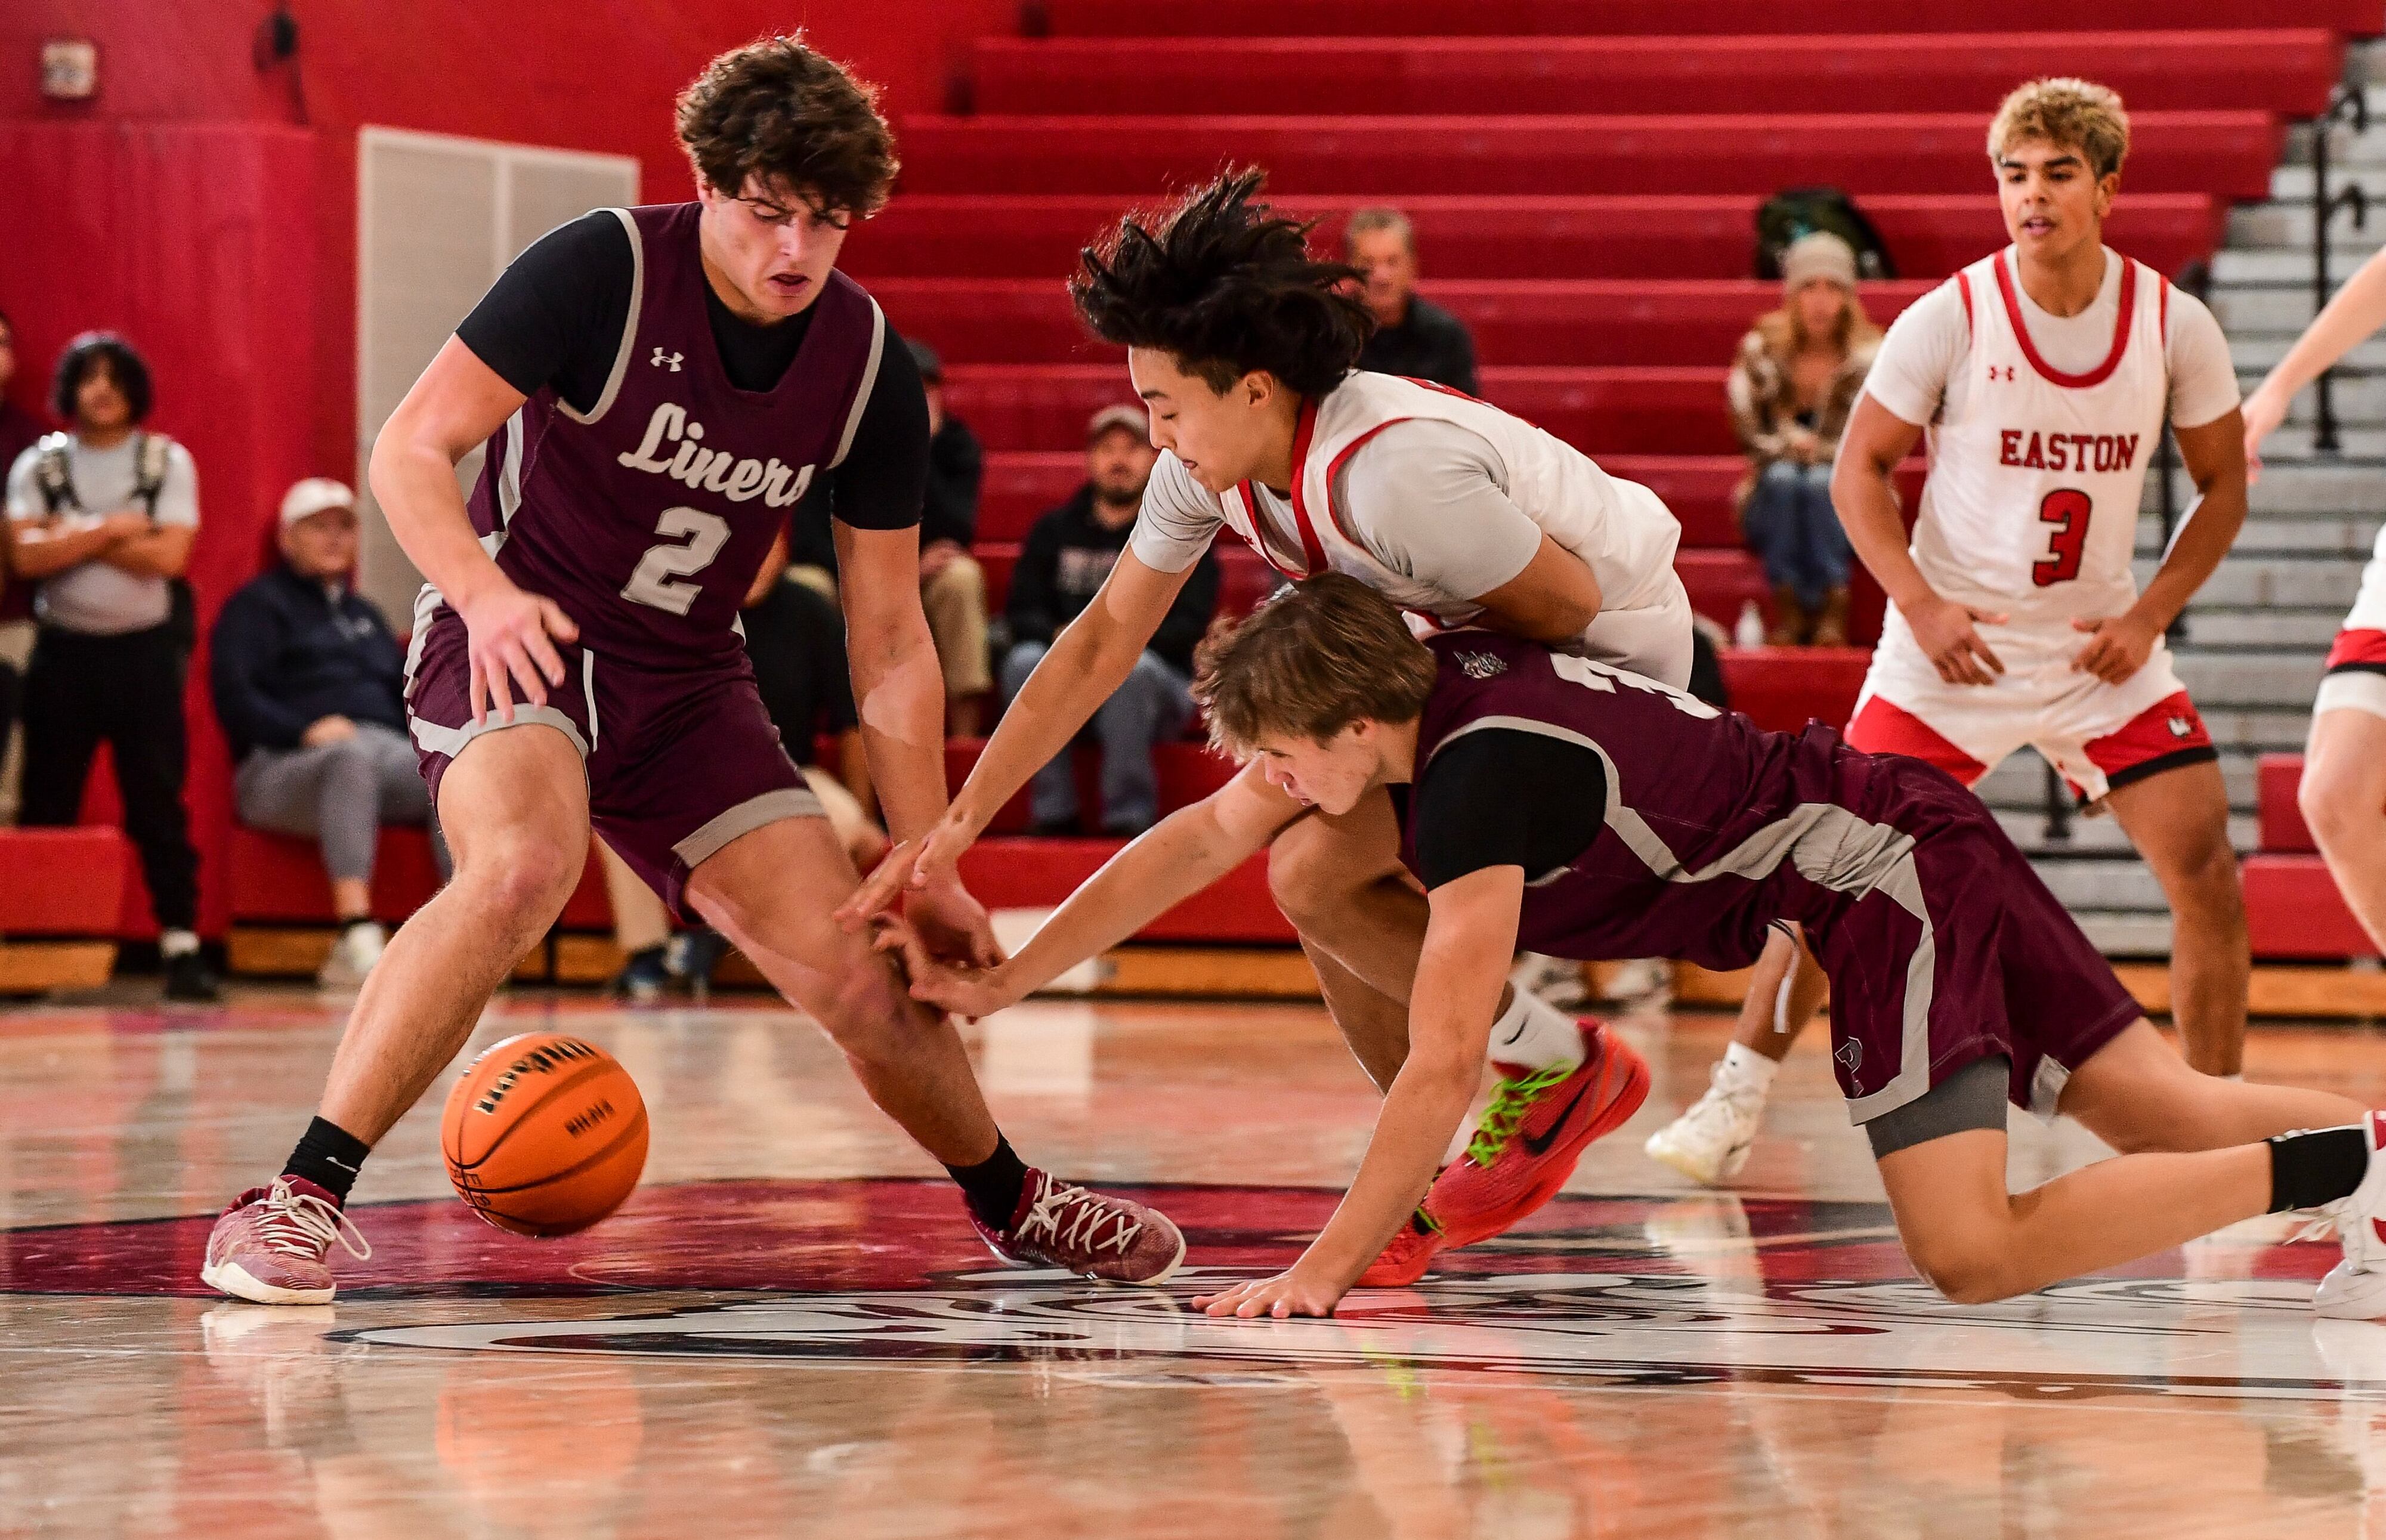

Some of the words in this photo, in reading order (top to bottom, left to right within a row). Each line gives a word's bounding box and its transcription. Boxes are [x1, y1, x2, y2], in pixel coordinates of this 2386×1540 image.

[617, 403, 816, 507] Liners
[2001, 431, 2139, 472] EASTON
[620, 506, 732, 616] 2
[2032, 488, 2093, 587] 3
